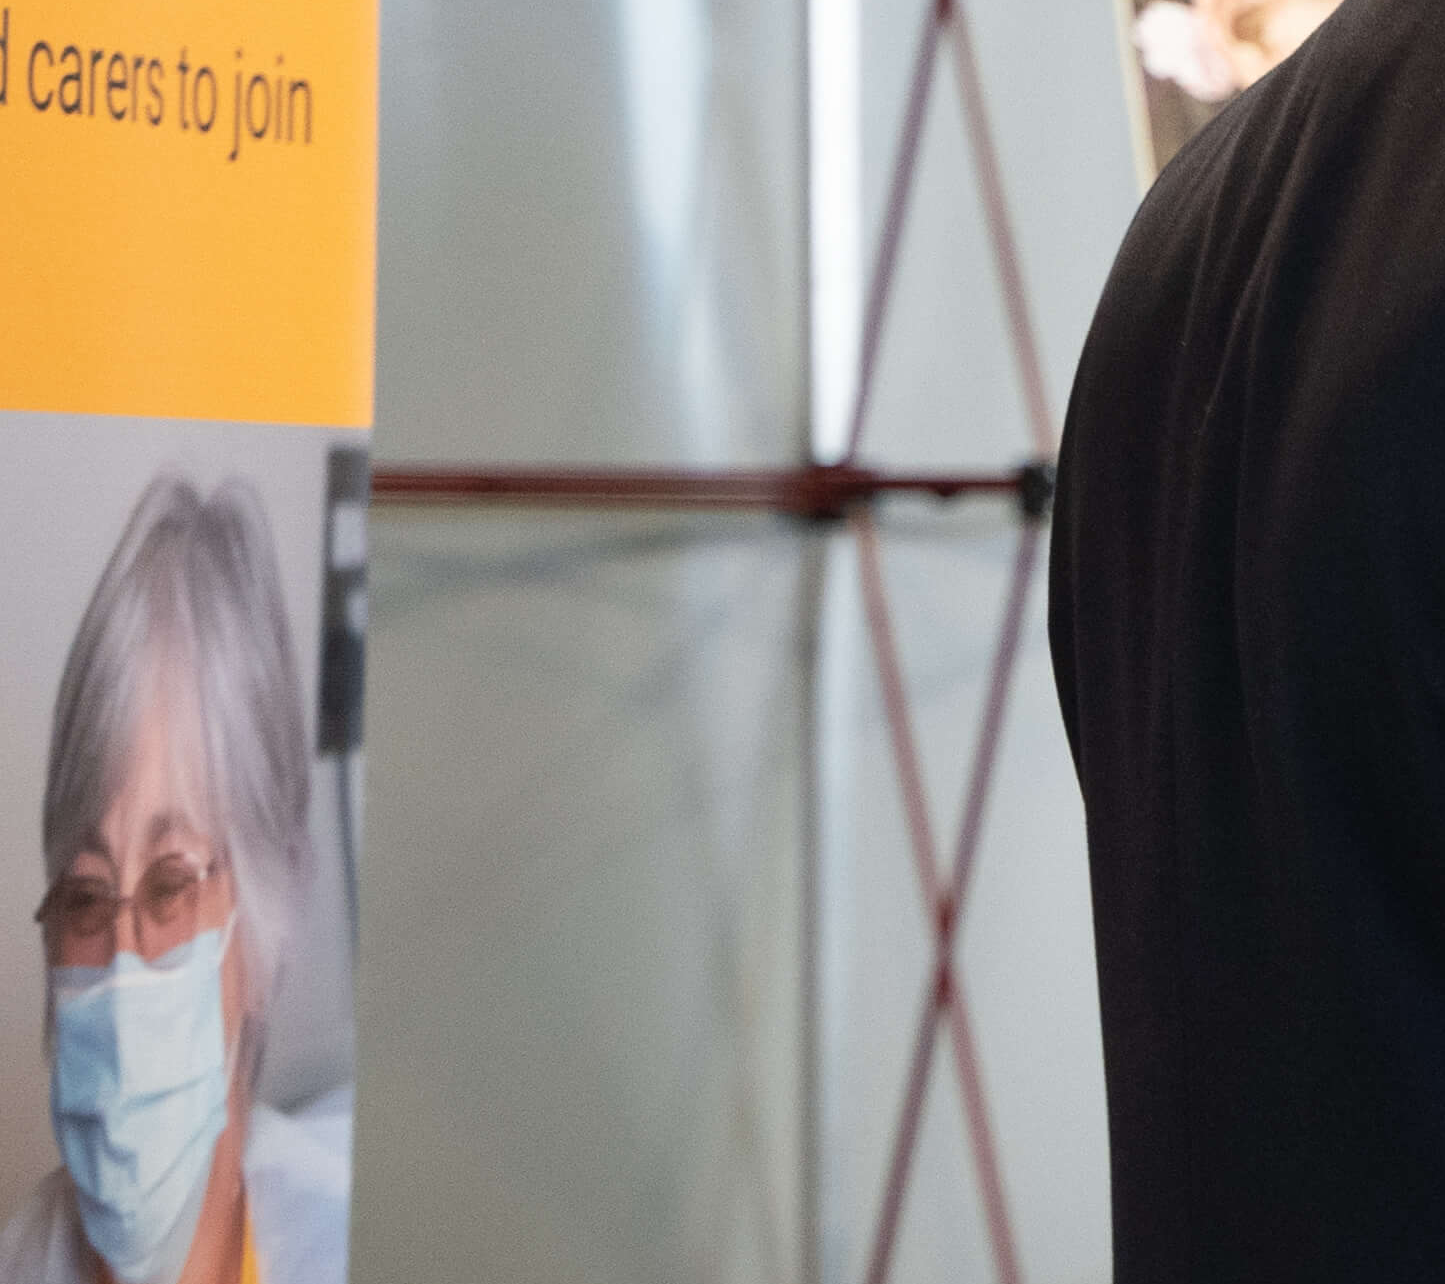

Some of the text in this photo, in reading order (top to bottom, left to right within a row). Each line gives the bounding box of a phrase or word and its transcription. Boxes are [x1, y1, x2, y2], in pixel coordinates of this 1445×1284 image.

[27, 39, 164, 126] carers
[176, 45, 218, 131] to
[227, 48, 313, 162] join
